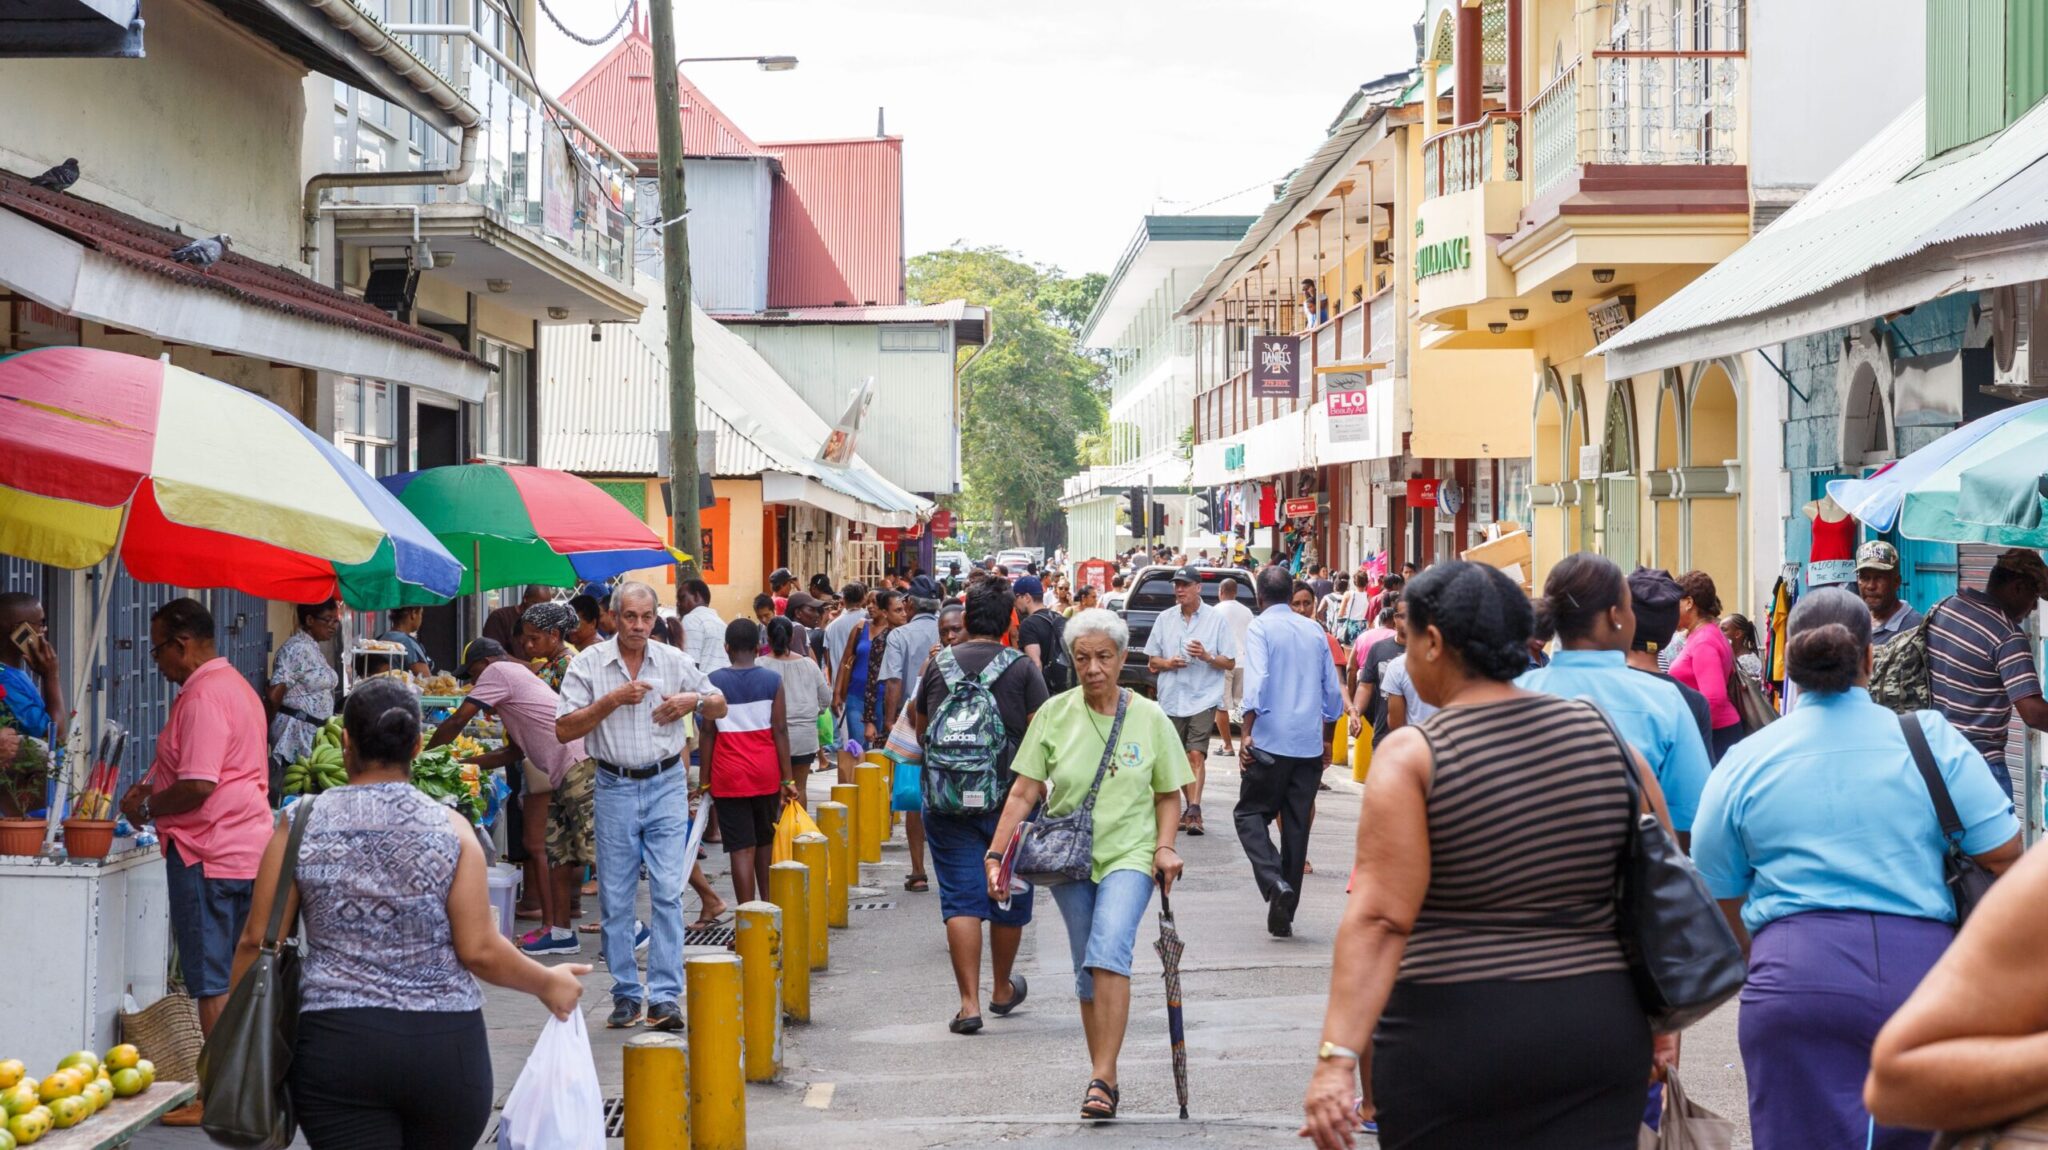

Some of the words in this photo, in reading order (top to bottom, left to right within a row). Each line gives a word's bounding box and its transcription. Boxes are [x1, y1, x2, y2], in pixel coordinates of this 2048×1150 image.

[1329, 392, 1365, 408] FLO
[1330, 407, 1355, 415] Beauty
[1816, 573, 1828, 581] THE
[1831, 572, 1849, 581] SET
[943, 733, 977, 742] adidas
